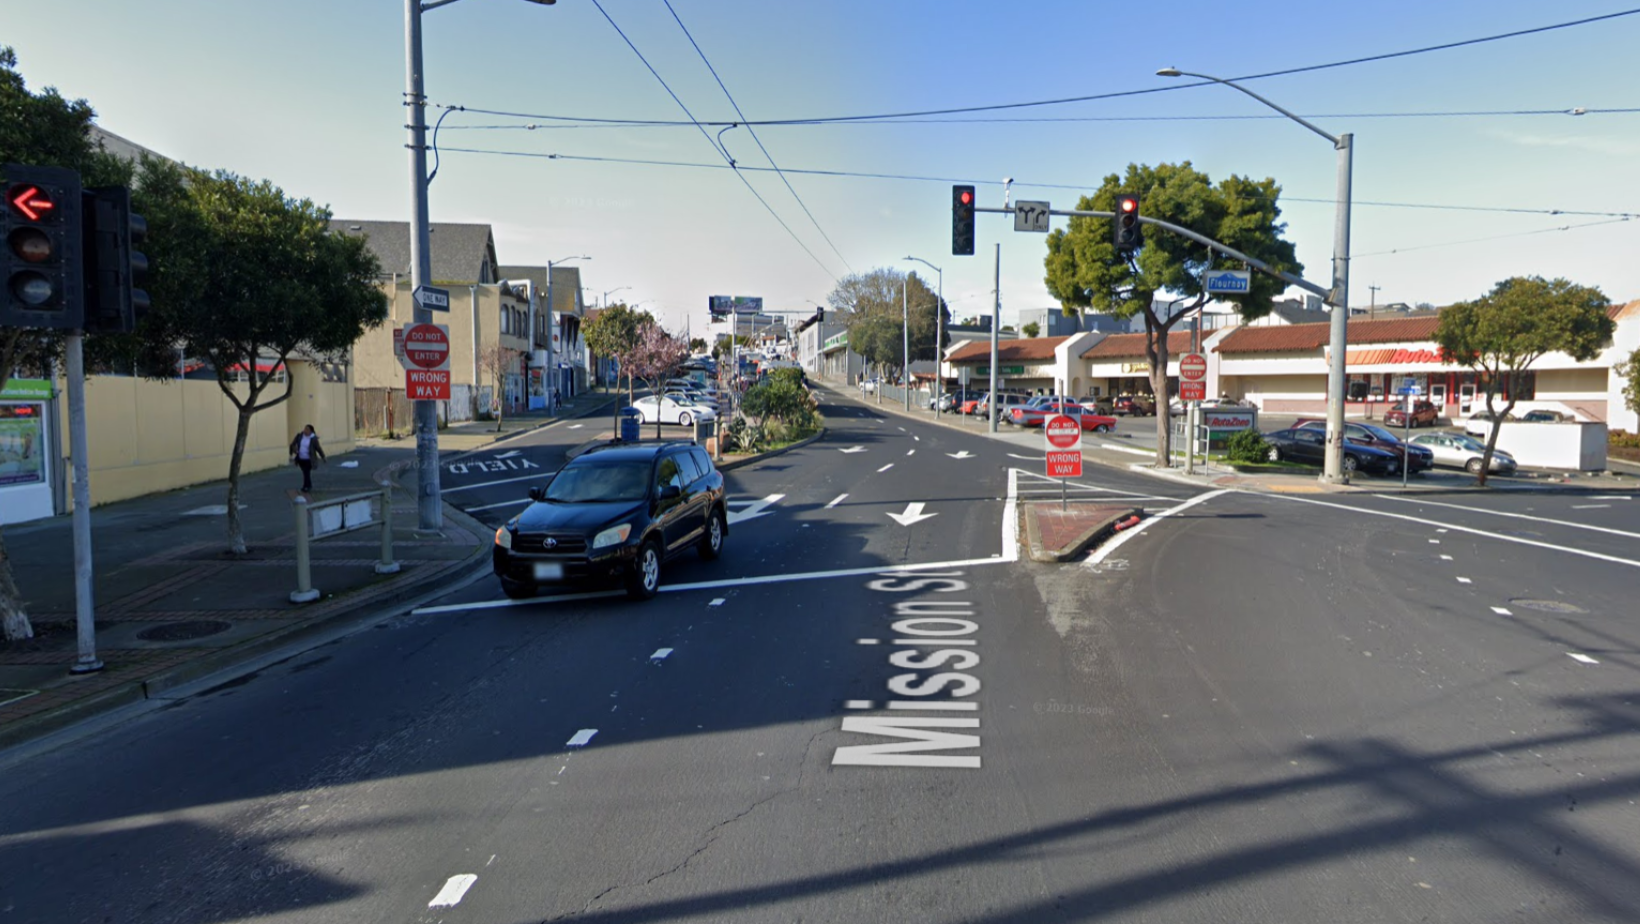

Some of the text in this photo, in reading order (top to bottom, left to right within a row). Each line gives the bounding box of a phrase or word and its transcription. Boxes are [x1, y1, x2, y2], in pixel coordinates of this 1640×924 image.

[1210, 278, 1246, 290] Flournoy
[423, 292, 447, 305] ONE WAY
[412, 332, 441, 341] DO NOT
[414, 352, 440, 360] ENTER
[410, 372, 447, 383] WRONG
[416, 386, 441, 396] WAY
[1211, 416, 1250, 427] AutoZone
[1048, 453, 1079, 463] WRONG
[1055, 465, 1074, 474] WAY
[831, 601, 981, 768] Mission
